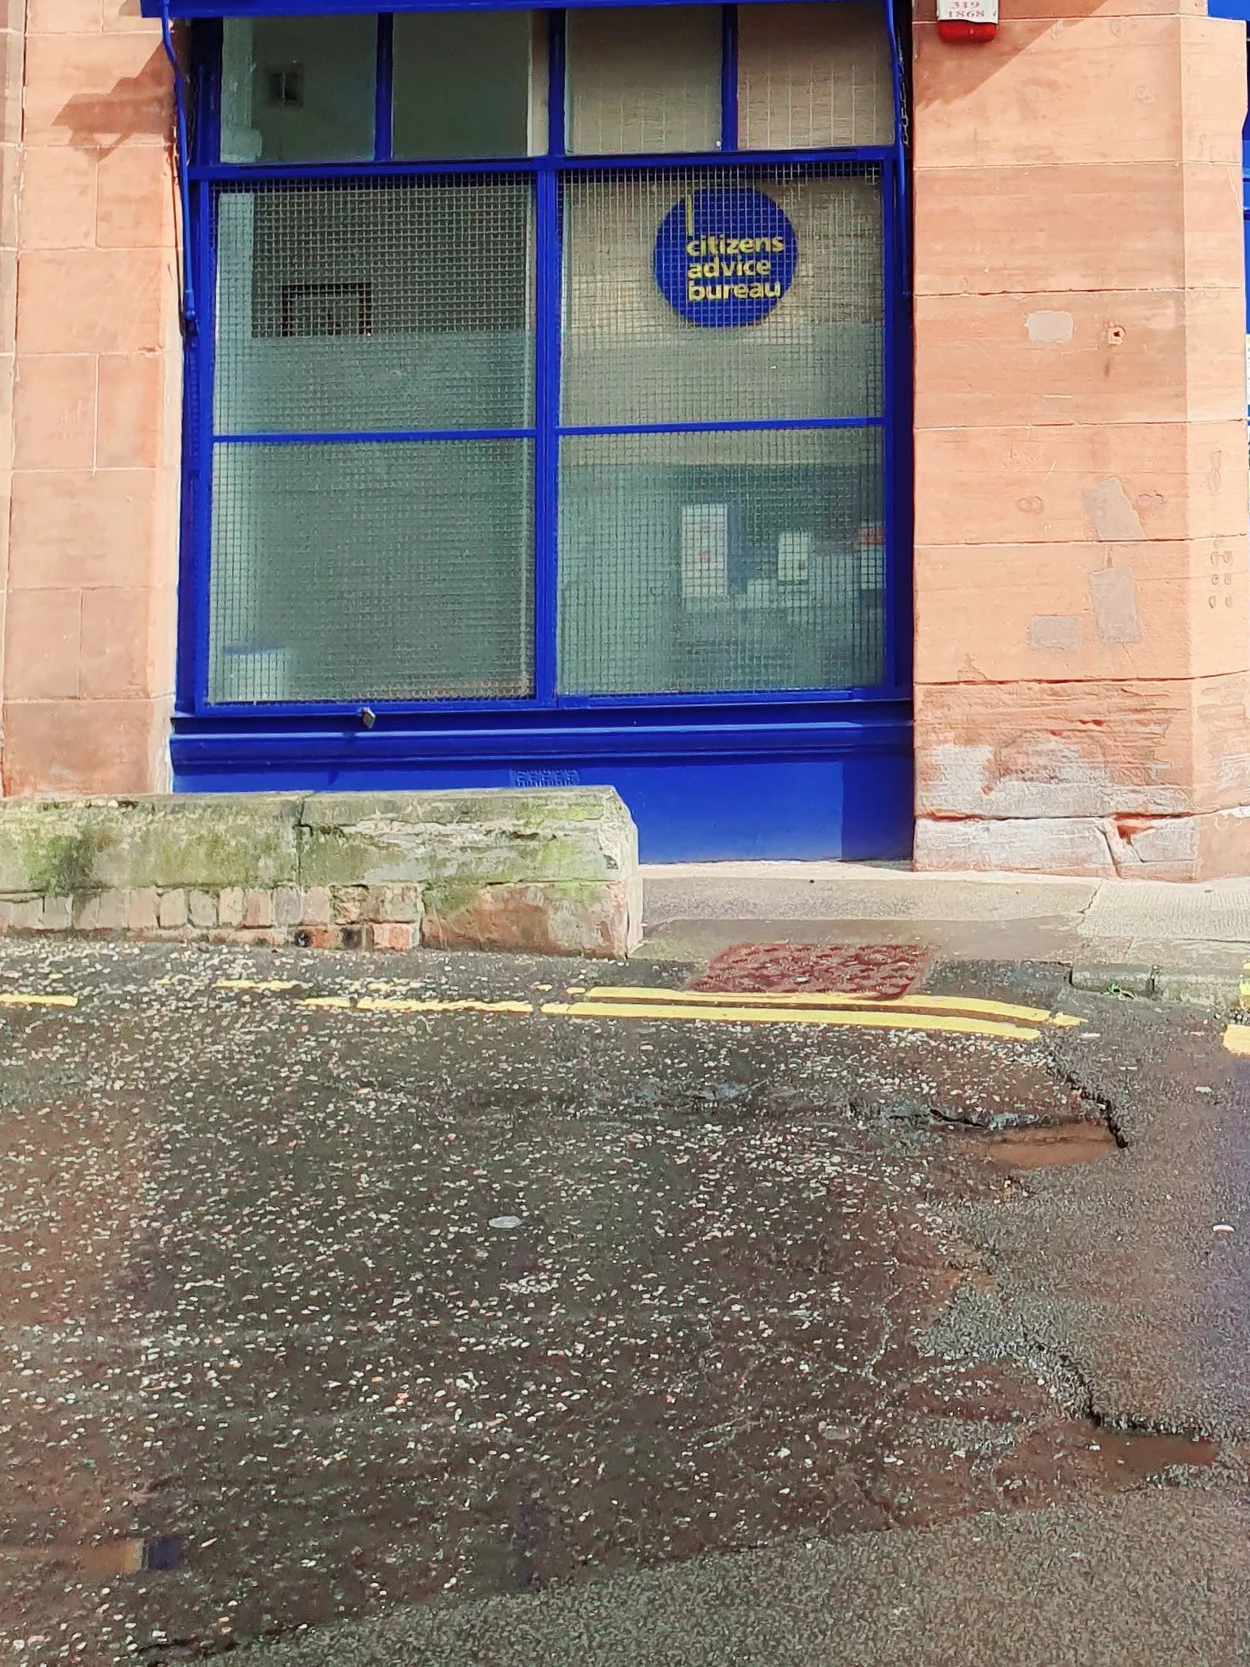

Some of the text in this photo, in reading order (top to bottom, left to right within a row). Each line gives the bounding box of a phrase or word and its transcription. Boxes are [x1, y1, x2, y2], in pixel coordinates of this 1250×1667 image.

[947, 10, 985, 18] 1868
[951, 1, 980, 9] 319
[686, 234, 785, 257] citizens
[687, 254, 772, 279] advice
[687, 280, 781, 302] bureau
